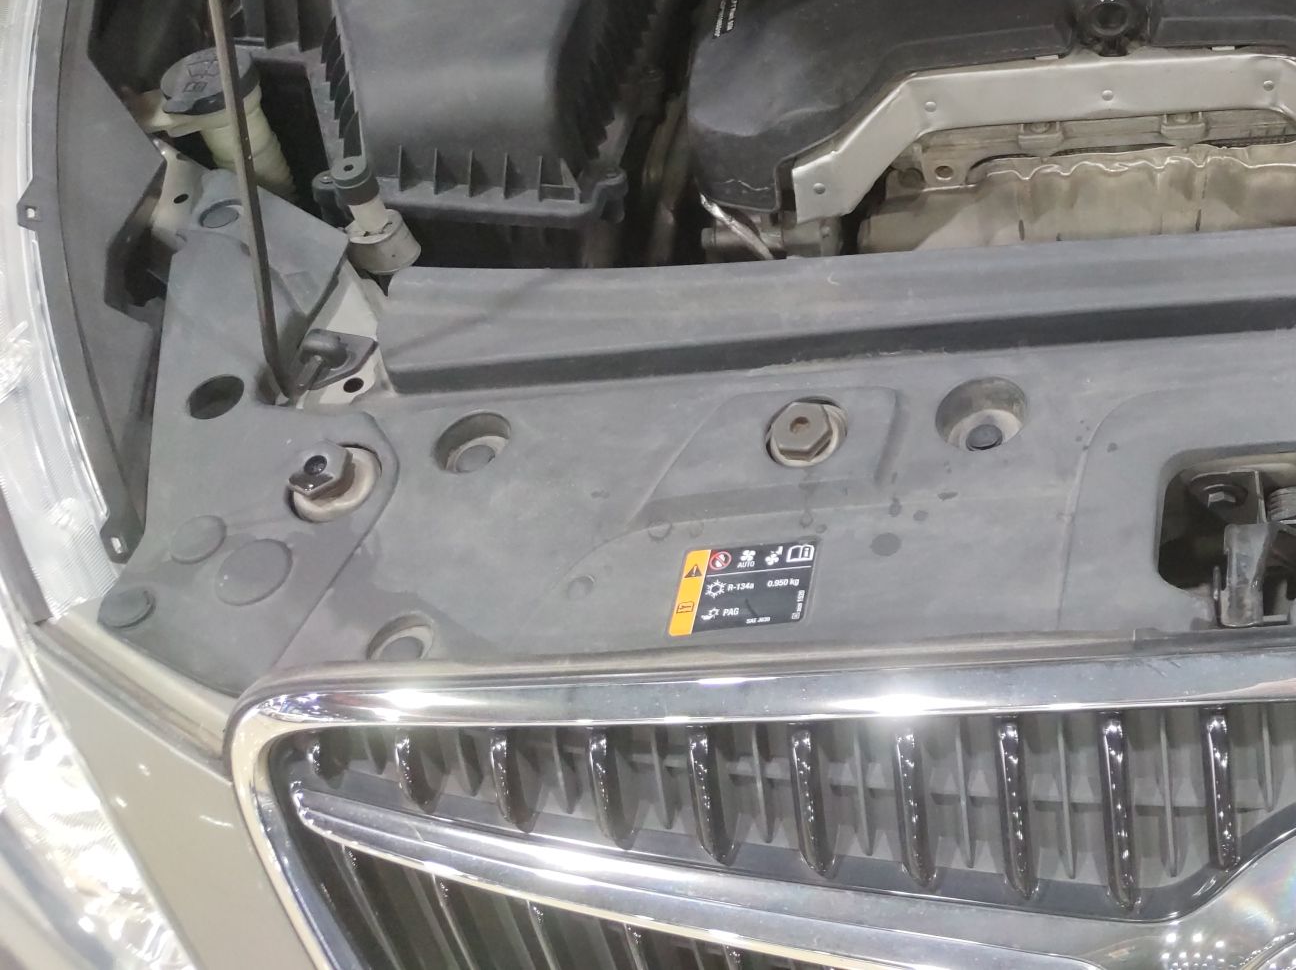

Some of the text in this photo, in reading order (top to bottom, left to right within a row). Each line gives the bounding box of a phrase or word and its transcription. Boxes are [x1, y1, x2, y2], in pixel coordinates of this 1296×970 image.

[727, 578, 800, 591] R-134a 0.950 kg
[722, 607, 740, 616] PAG
